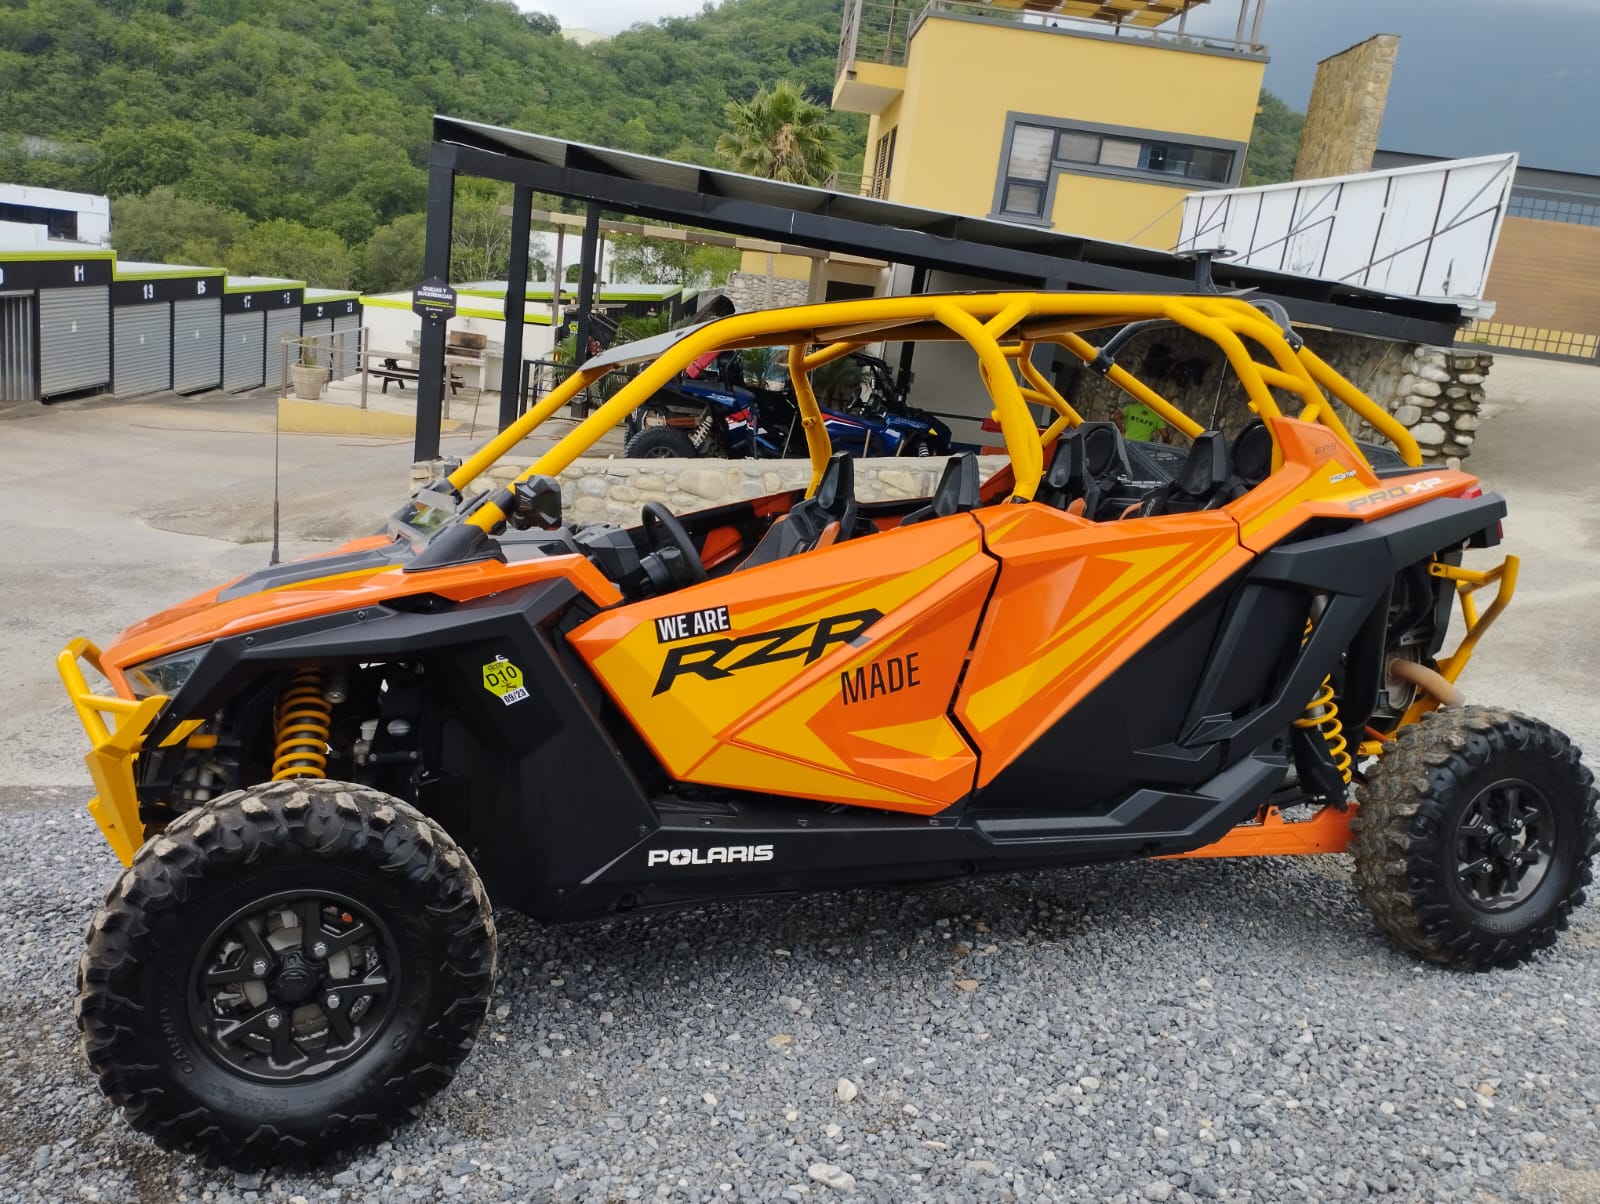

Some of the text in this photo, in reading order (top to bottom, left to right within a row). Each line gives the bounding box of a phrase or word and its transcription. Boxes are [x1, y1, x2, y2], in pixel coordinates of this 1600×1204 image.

[73, 264, 84, 282] 11
[143, 283, 154, 299] 13
[197, 280, 206, 295] 15
[1130, 415, 1154, 427] STAFF
[1348, 477, 1442, 513] PRO XP
[658, 607, 730, 641] WE ARE
[651, 608, 886, 698] RZR
[486, 664, 518, 688] D10
[841, 651, 921, 706] MADE
[503, 689, 527, 704] 09/23
[647, 844, 774, 867] POLARIS
